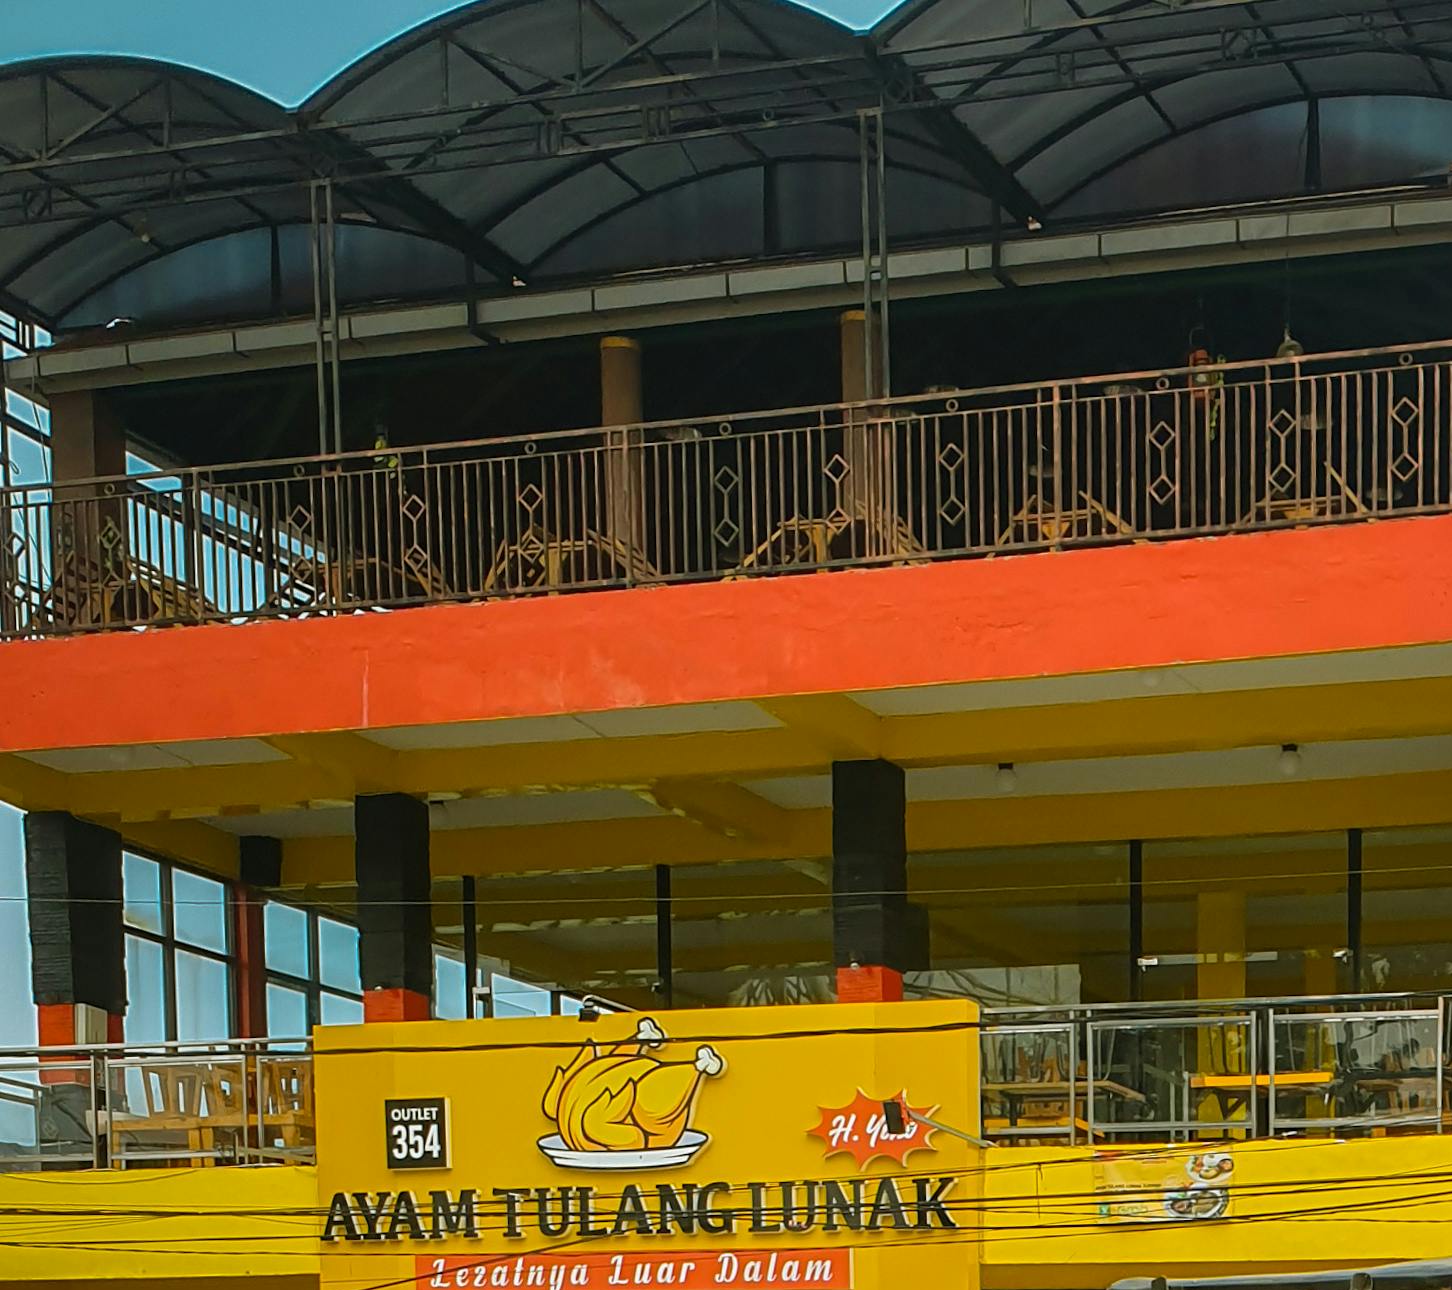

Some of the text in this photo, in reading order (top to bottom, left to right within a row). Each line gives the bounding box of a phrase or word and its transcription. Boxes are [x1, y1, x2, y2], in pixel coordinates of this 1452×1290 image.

[391, 1106, 439, 1121] OUTLET
[828, 1113, 859, 1148] H.
[392, 1123, 441, 1160] 354
[320, 1177, 959, 1242] AYAM TULANG LUNAK
[608, 1253, 697, 1286] Luar
[714, 1251, 834, 1284] Dalam
